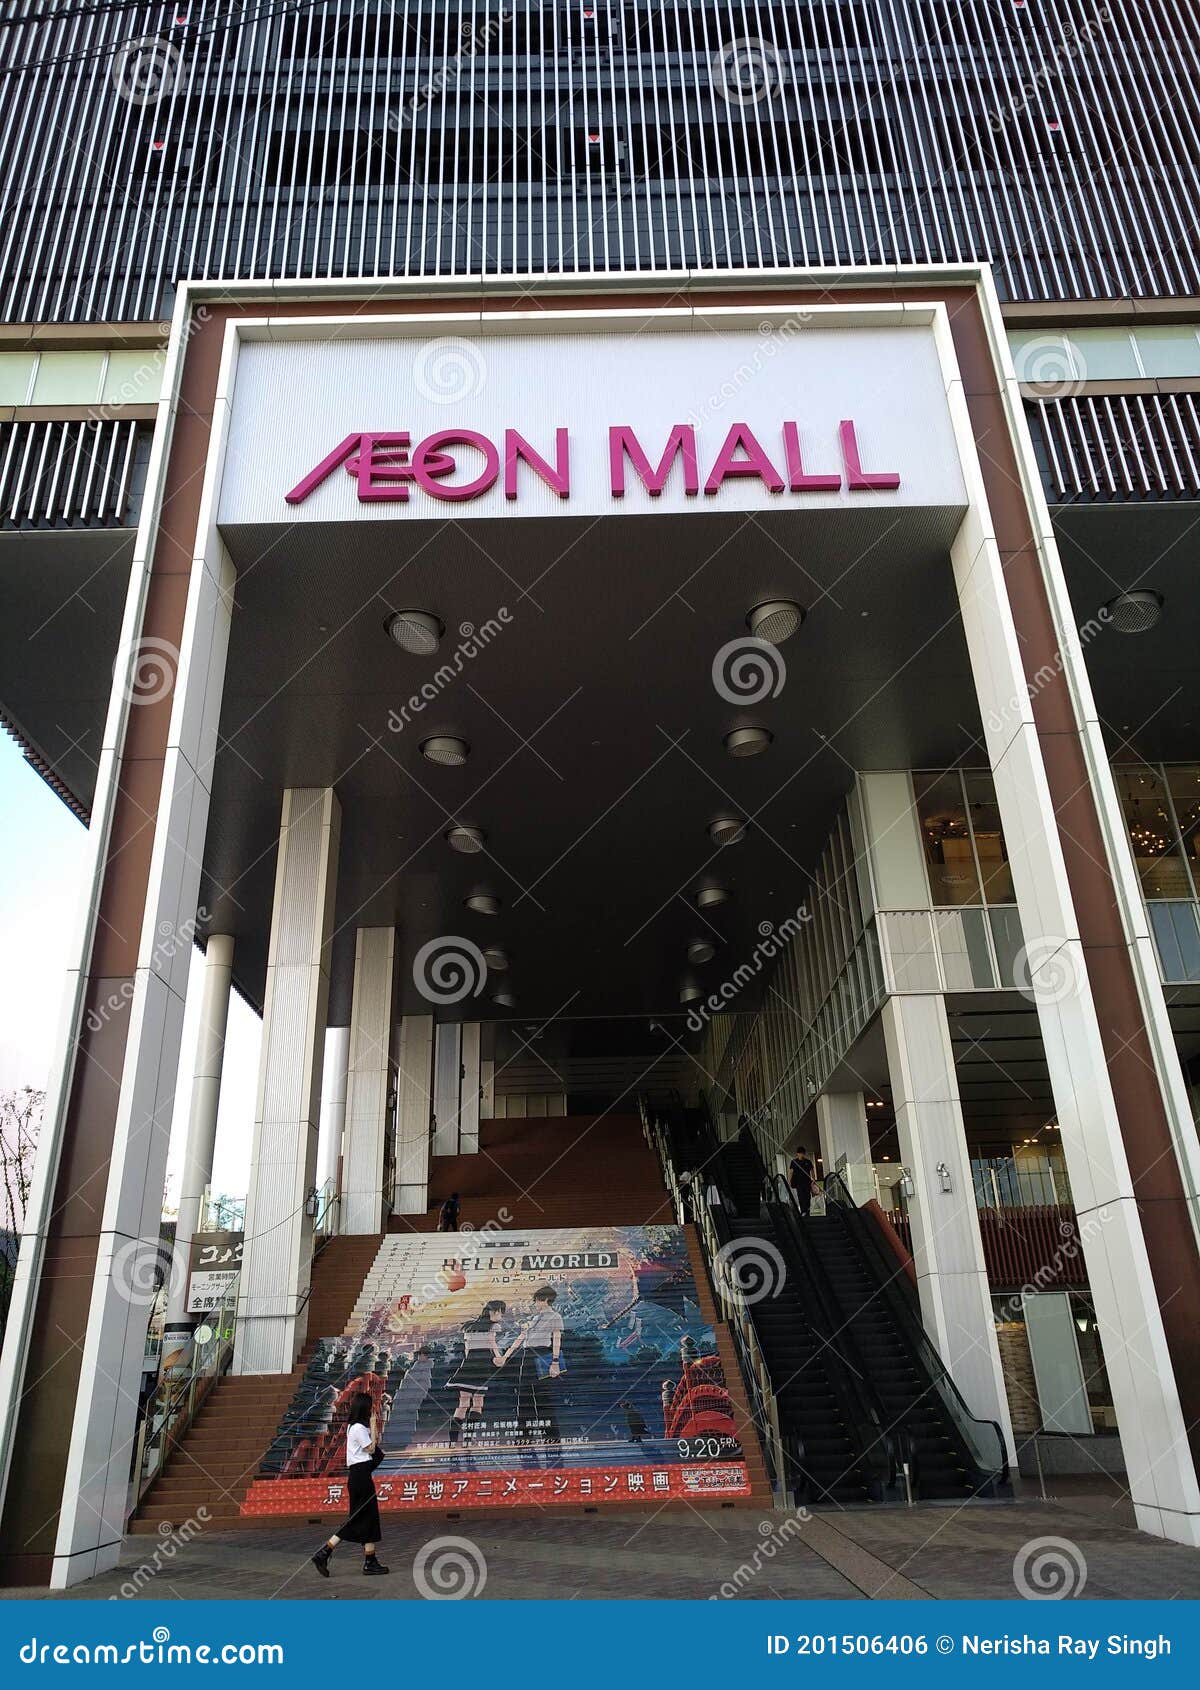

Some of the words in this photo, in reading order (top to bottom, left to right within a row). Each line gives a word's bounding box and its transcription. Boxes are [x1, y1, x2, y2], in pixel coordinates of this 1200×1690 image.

[609, 420, 900, 496] MALL
[442, 1256, 516, 1271] HELLO
[529, 1253, 613, 1269] WORLD
[677, 1438, 720, 1458] 9.20
[323, 1471, 670, 1504] 京ご当地アニメーション映画
